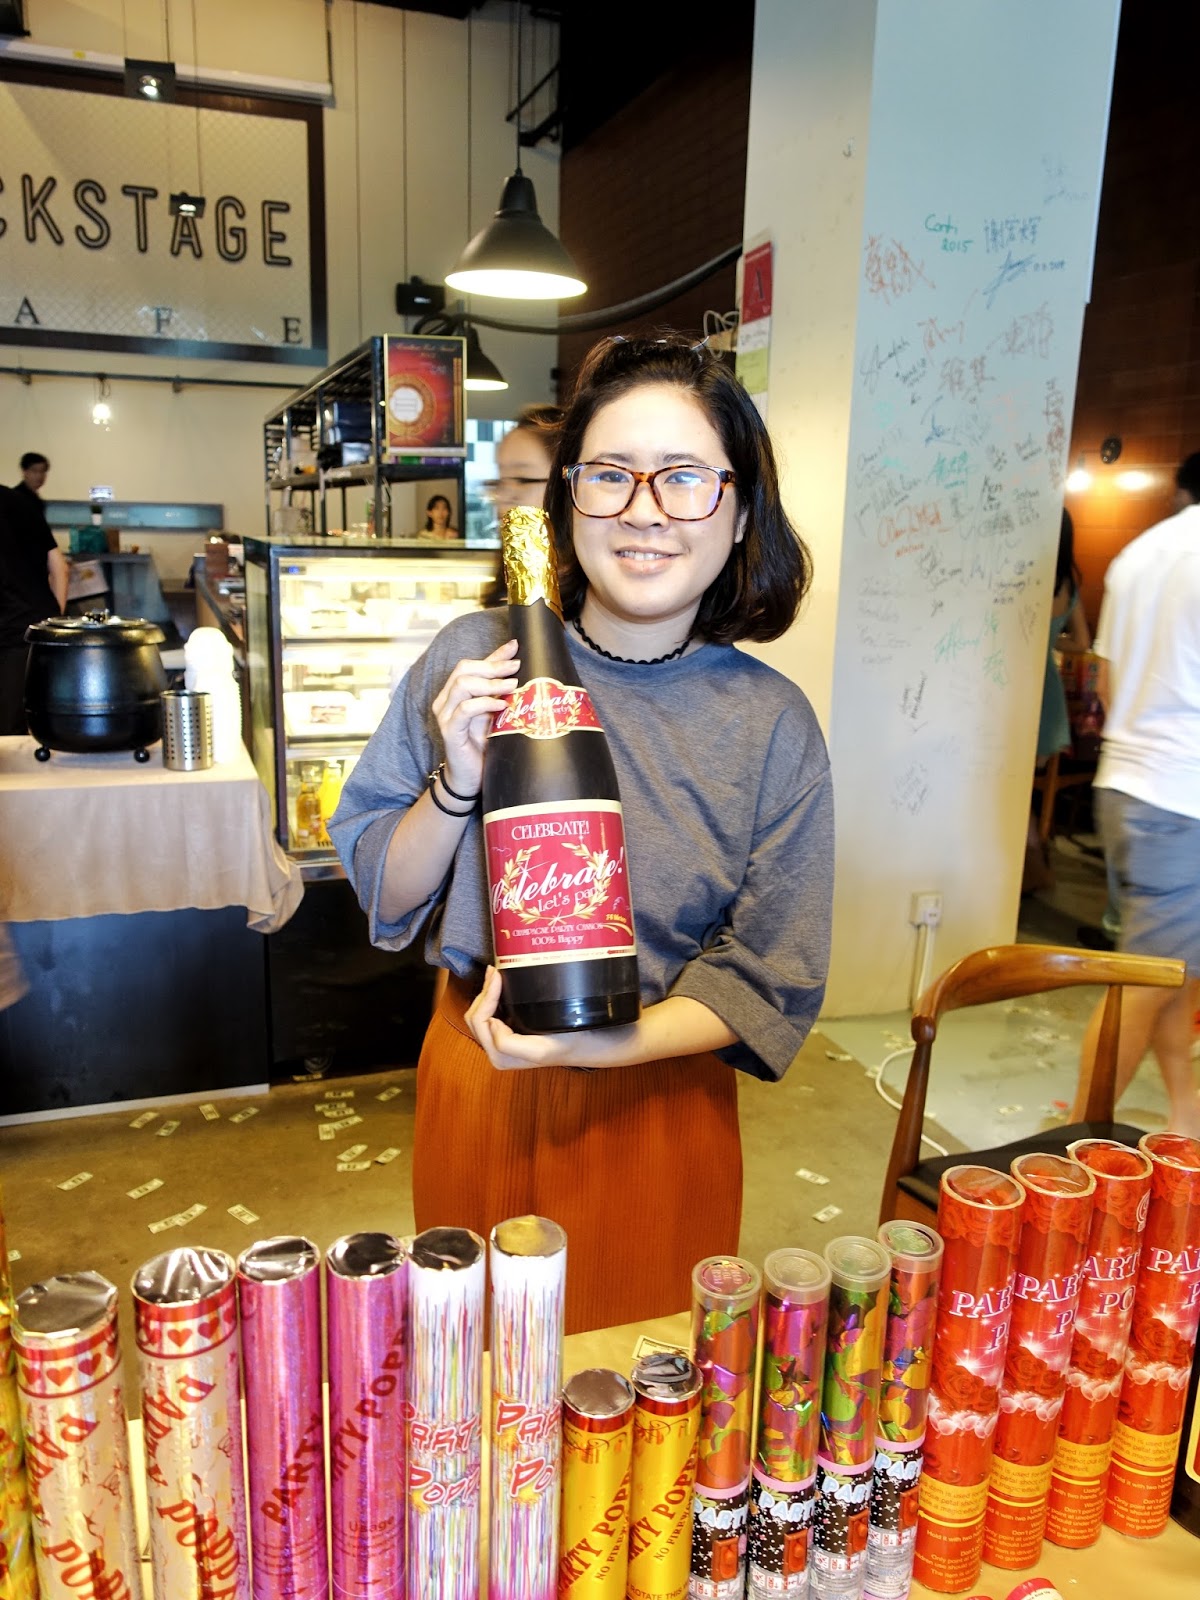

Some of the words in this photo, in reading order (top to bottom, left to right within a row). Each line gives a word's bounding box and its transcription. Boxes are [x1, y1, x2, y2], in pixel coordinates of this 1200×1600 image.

[0, 172, 293, 267] KSTAGE
[511, 820, 590, 841] CELEBRATE!
[492, 845, 624, 915] Celebrate!
[538, 891, 571, 912] Let's
[531, 936, 556, 946] 100%
[558, 934, 584, 945] Happy
[1081, 1250, 1139, 1281] ART
[402, 1400, 483, 1456] PART
